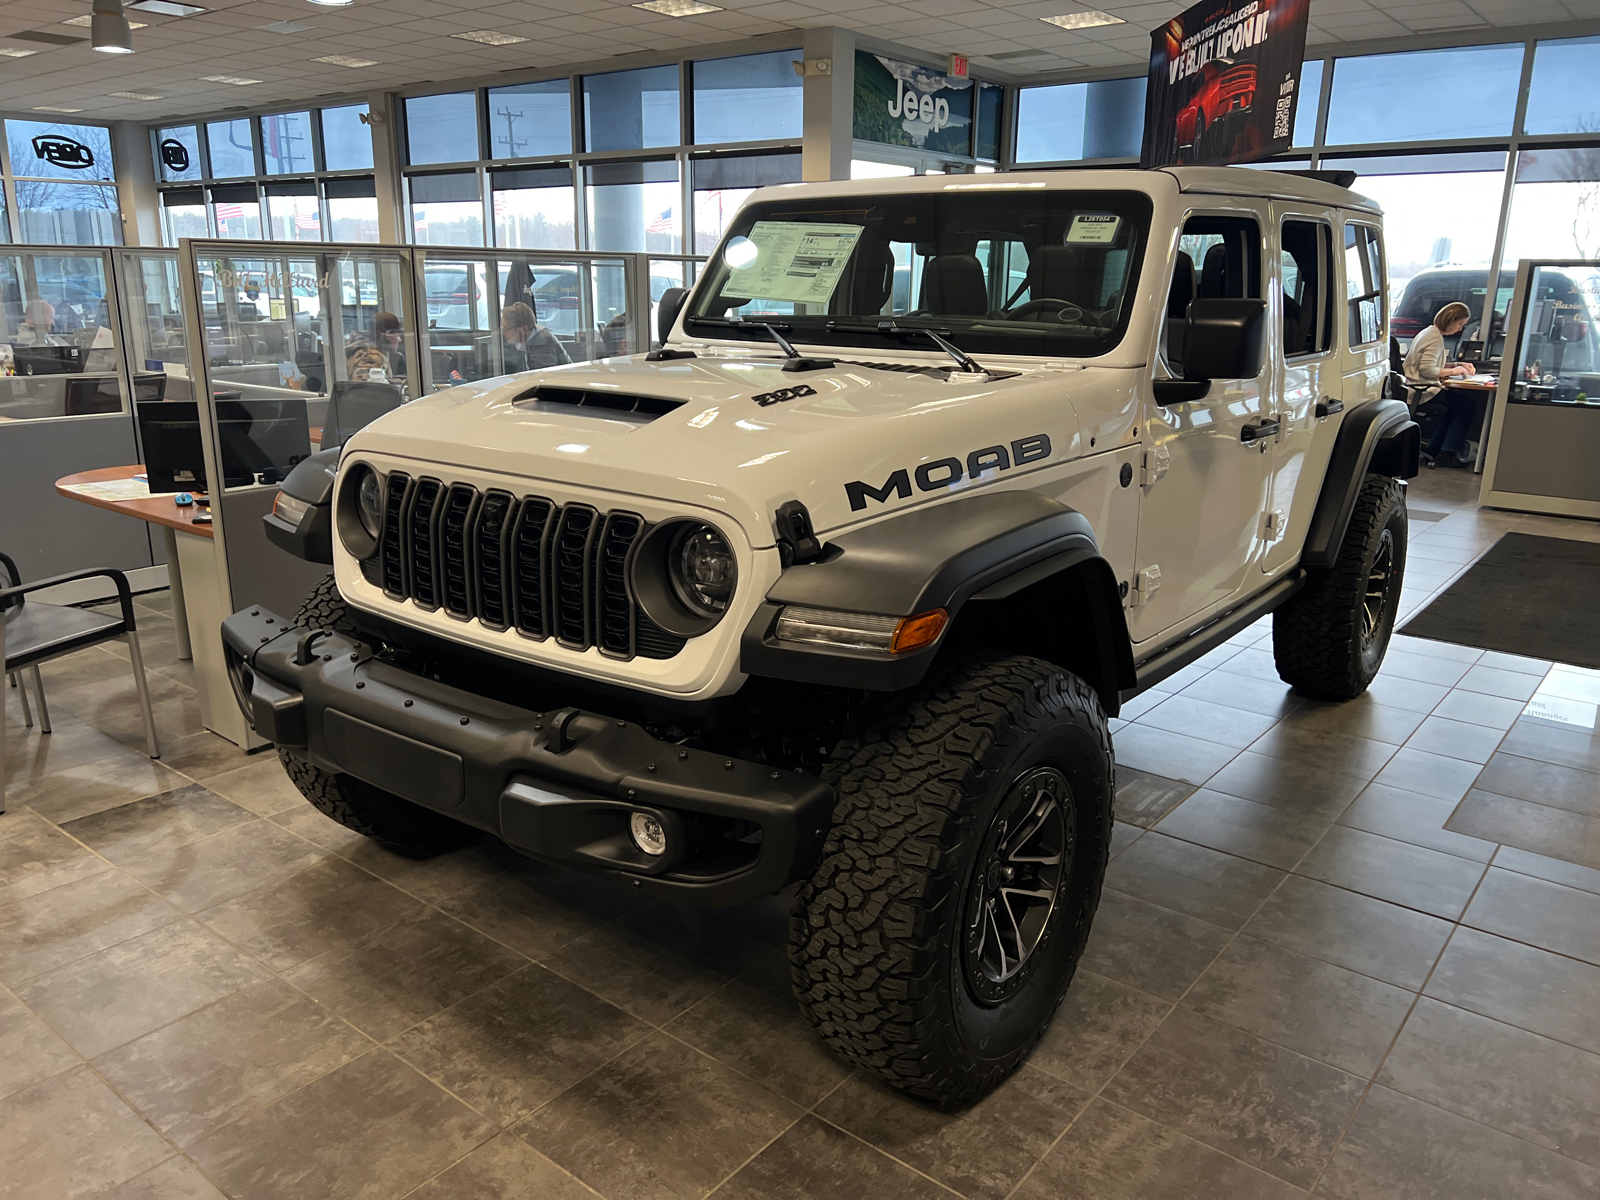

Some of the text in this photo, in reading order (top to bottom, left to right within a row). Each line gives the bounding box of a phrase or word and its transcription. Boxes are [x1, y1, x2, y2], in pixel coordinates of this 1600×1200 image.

[1216, 16, 1254, 58] UPON
[955, 56, 968, 77] EXIT
[888, 79, 949, 133] Jeep
[844, 433, 1052, 512] MOAB
